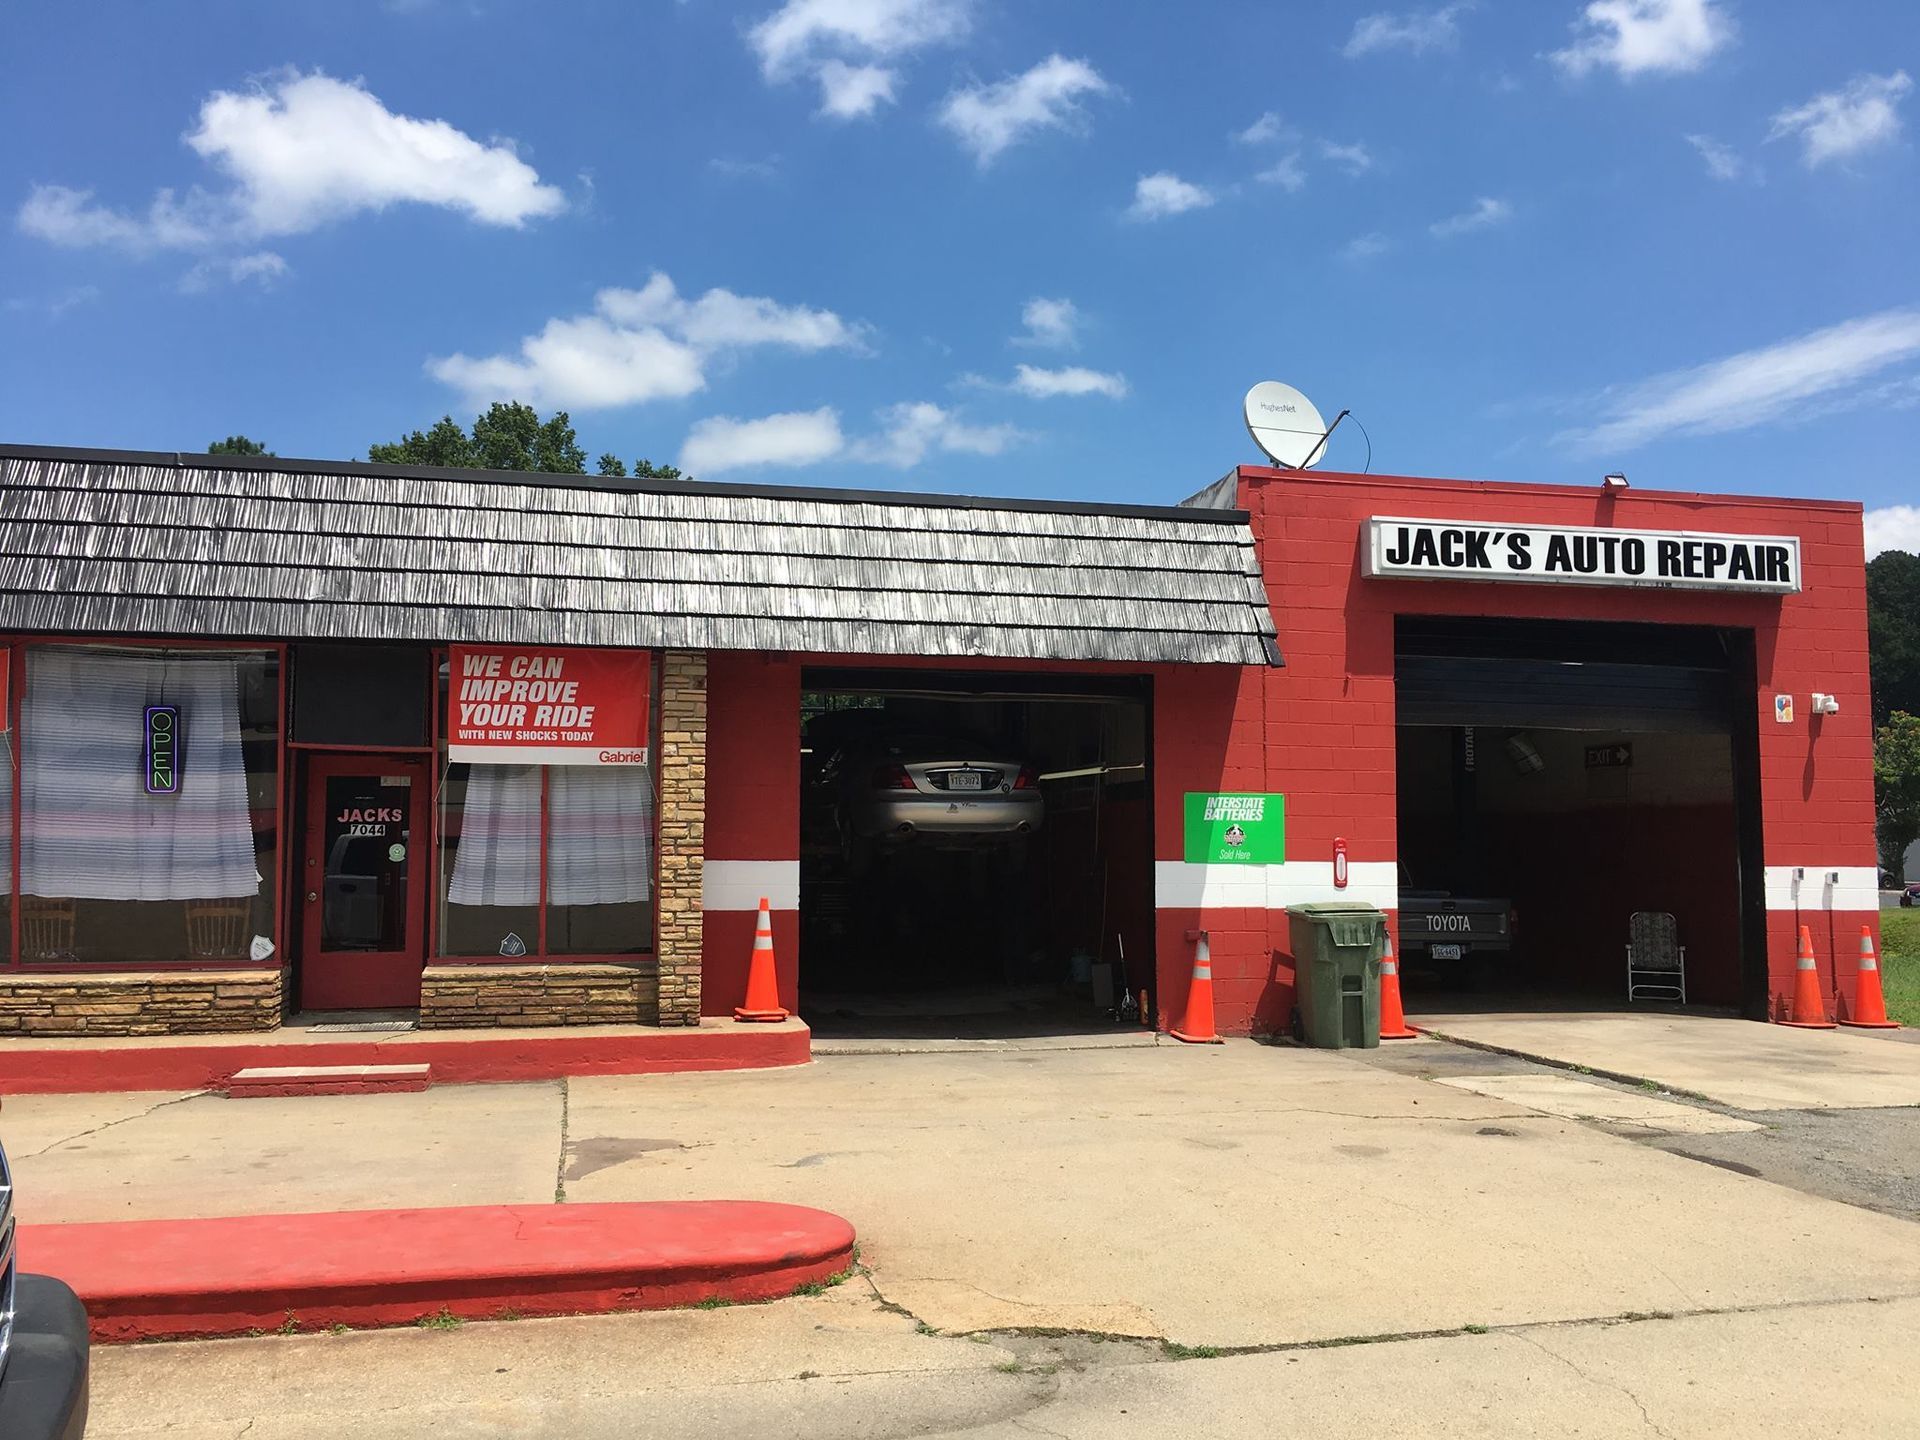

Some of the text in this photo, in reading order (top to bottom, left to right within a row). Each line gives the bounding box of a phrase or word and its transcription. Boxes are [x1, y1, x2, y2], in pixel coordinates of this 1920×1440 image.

[1260, 402, 1296, 414] HughesNet
[1386, 526, 1790, 582] JACK'S AUTO REPAIR
[463, 654, 564, 679] WE CAN
[460, 680, 579, 703] IMPROVE
[459, 703, 595, 727] YOUR RIDE
[458, 729, 594, 741] WITH NEW SHOCKS TODAY
[152, 713, 171, 787] OPEN
[599, 750, 645, 763] Gabriel
[1589, 749, 1611, 764] EXIT
[1207, 797, 1265, 808] INTERSTATE
[337, 808, 403, 823] JACKS
[1204, 809, 1264, 820] BATTERIES
[352, 824, 385, 836] 7044
[1219, 849, 1251, 860] Sold Here
[1426, 915, 1471, 931] TOYOTA
